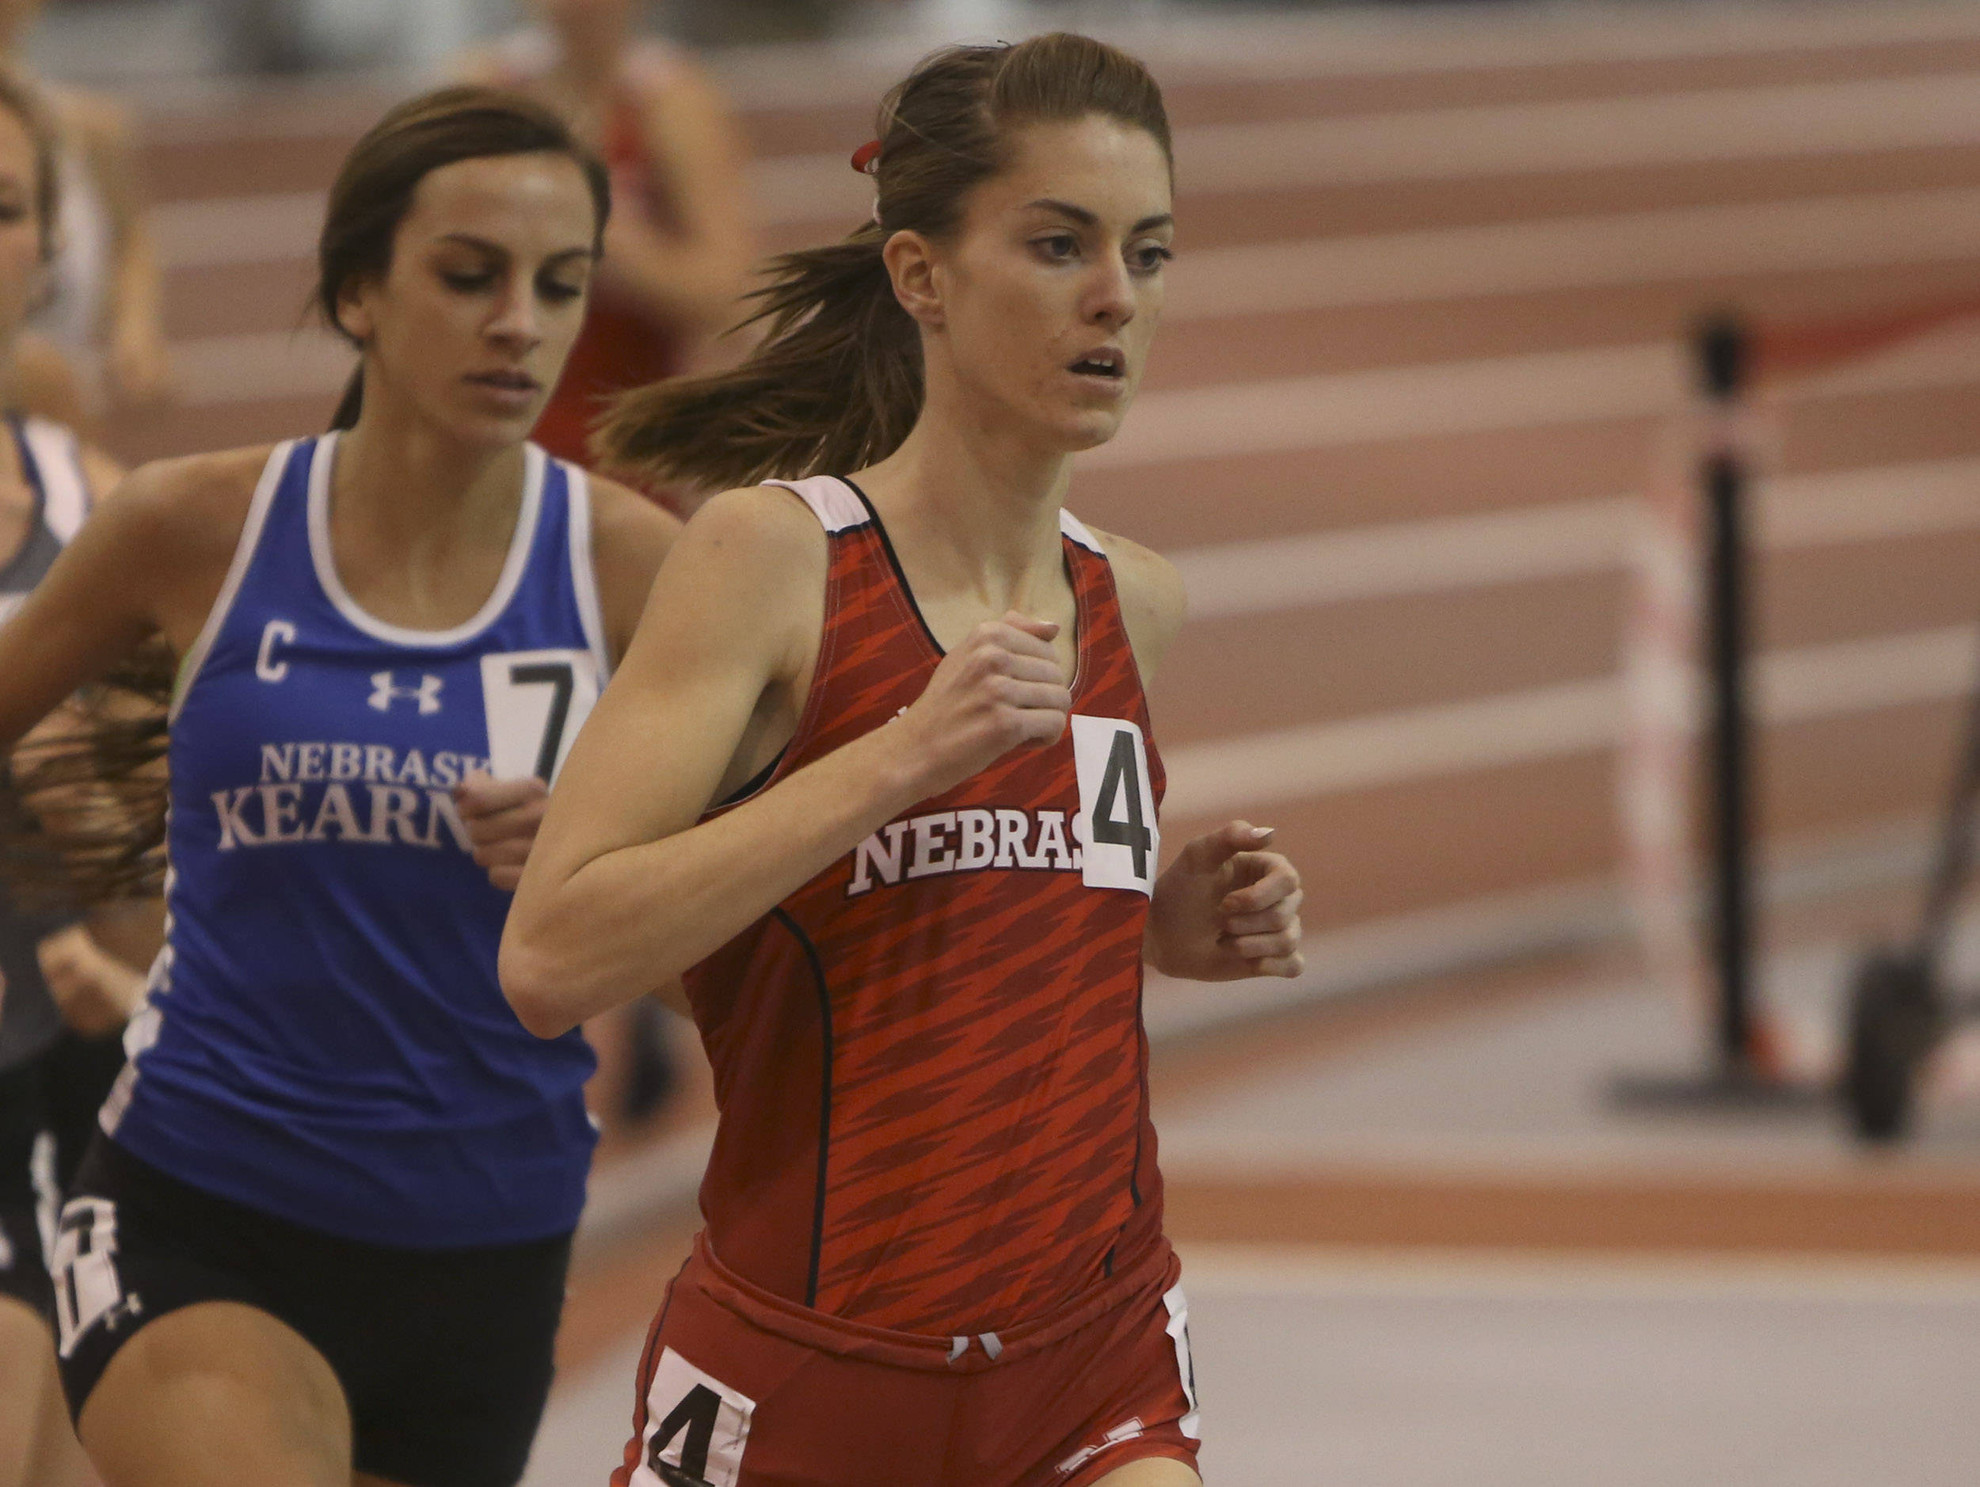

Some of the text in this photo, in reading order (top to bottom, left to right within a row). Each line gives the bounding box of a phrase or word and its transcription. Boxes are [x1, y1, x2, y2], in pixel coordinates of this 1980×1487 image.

[256, 620, 297, 683] C
[509, 661, 575, 789] 7
[1092, 729, 1152, 880] 4
[647, 1382, 716, 1487] 4
